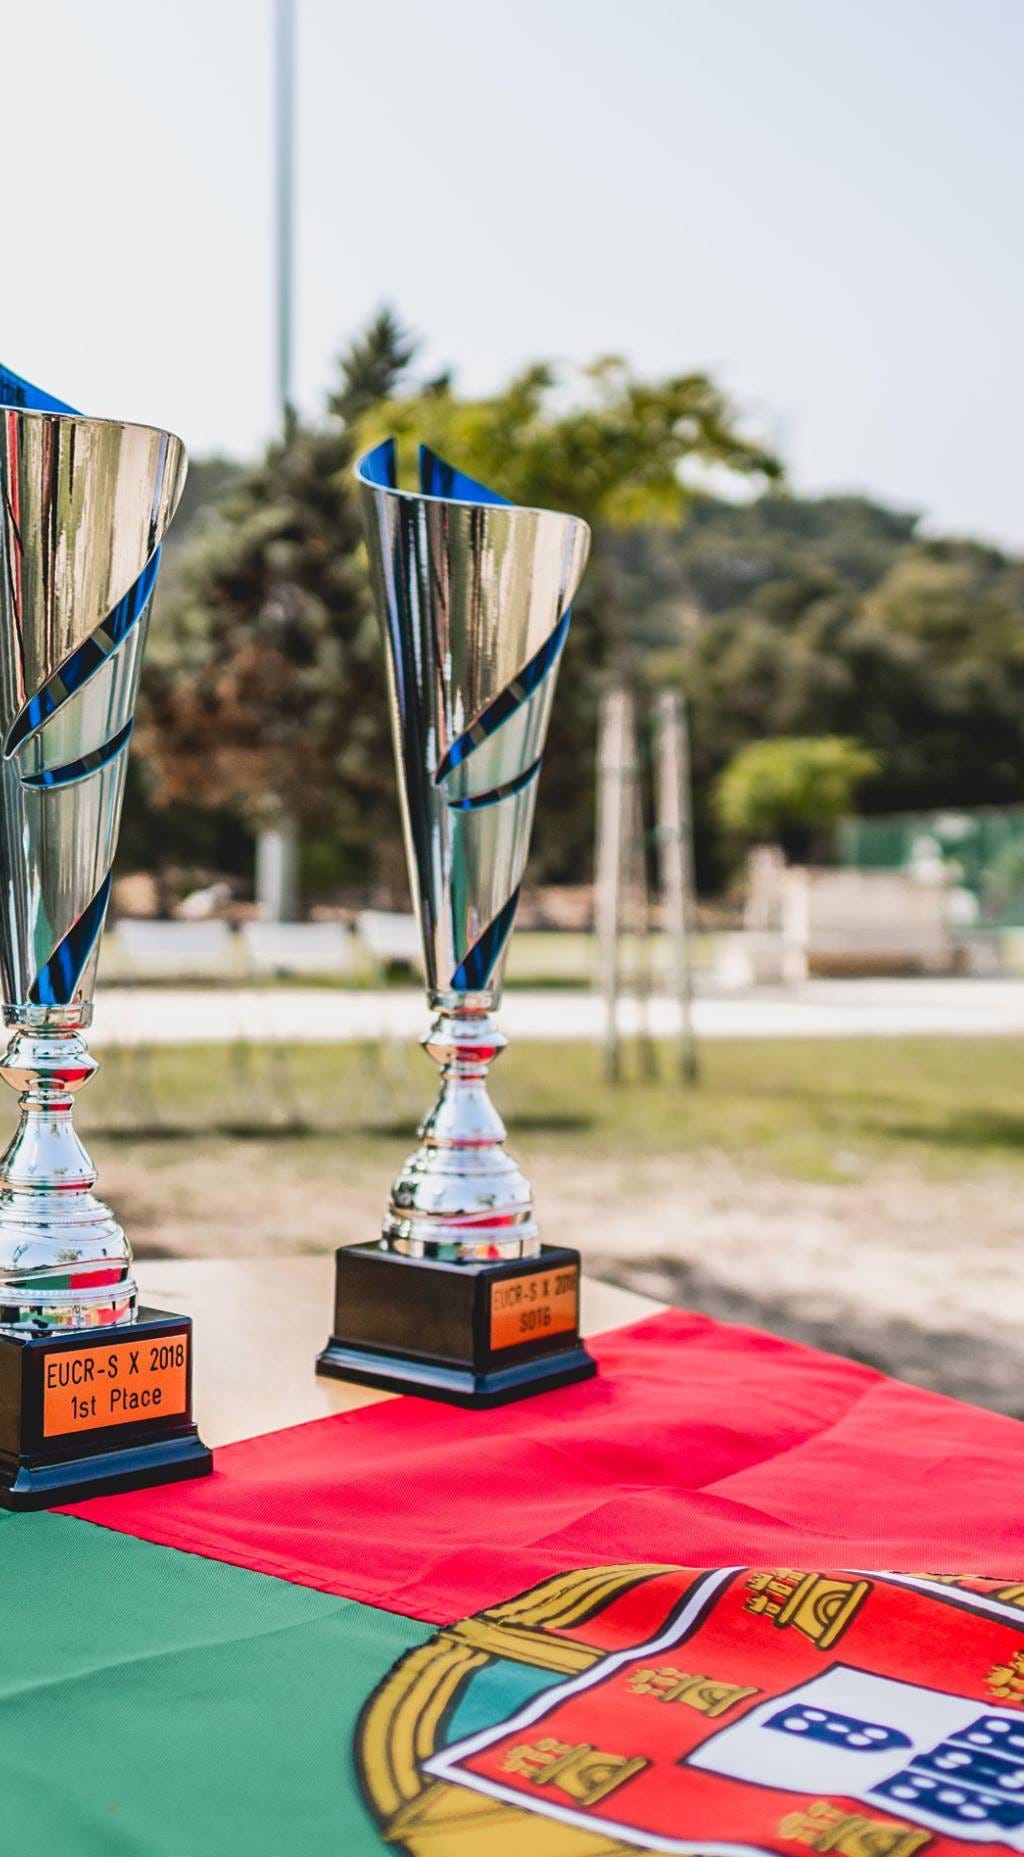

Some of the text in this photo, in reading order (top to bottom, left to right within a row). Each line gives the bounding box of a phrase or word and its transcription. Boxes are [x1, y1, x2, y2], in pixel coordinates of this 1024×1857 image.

[519, 1306, 552, 1333] SOTG
[47, 1343, 185, 1389] EUCR-S X 2018
[71, 1387, 163, 1419] 1st Place
